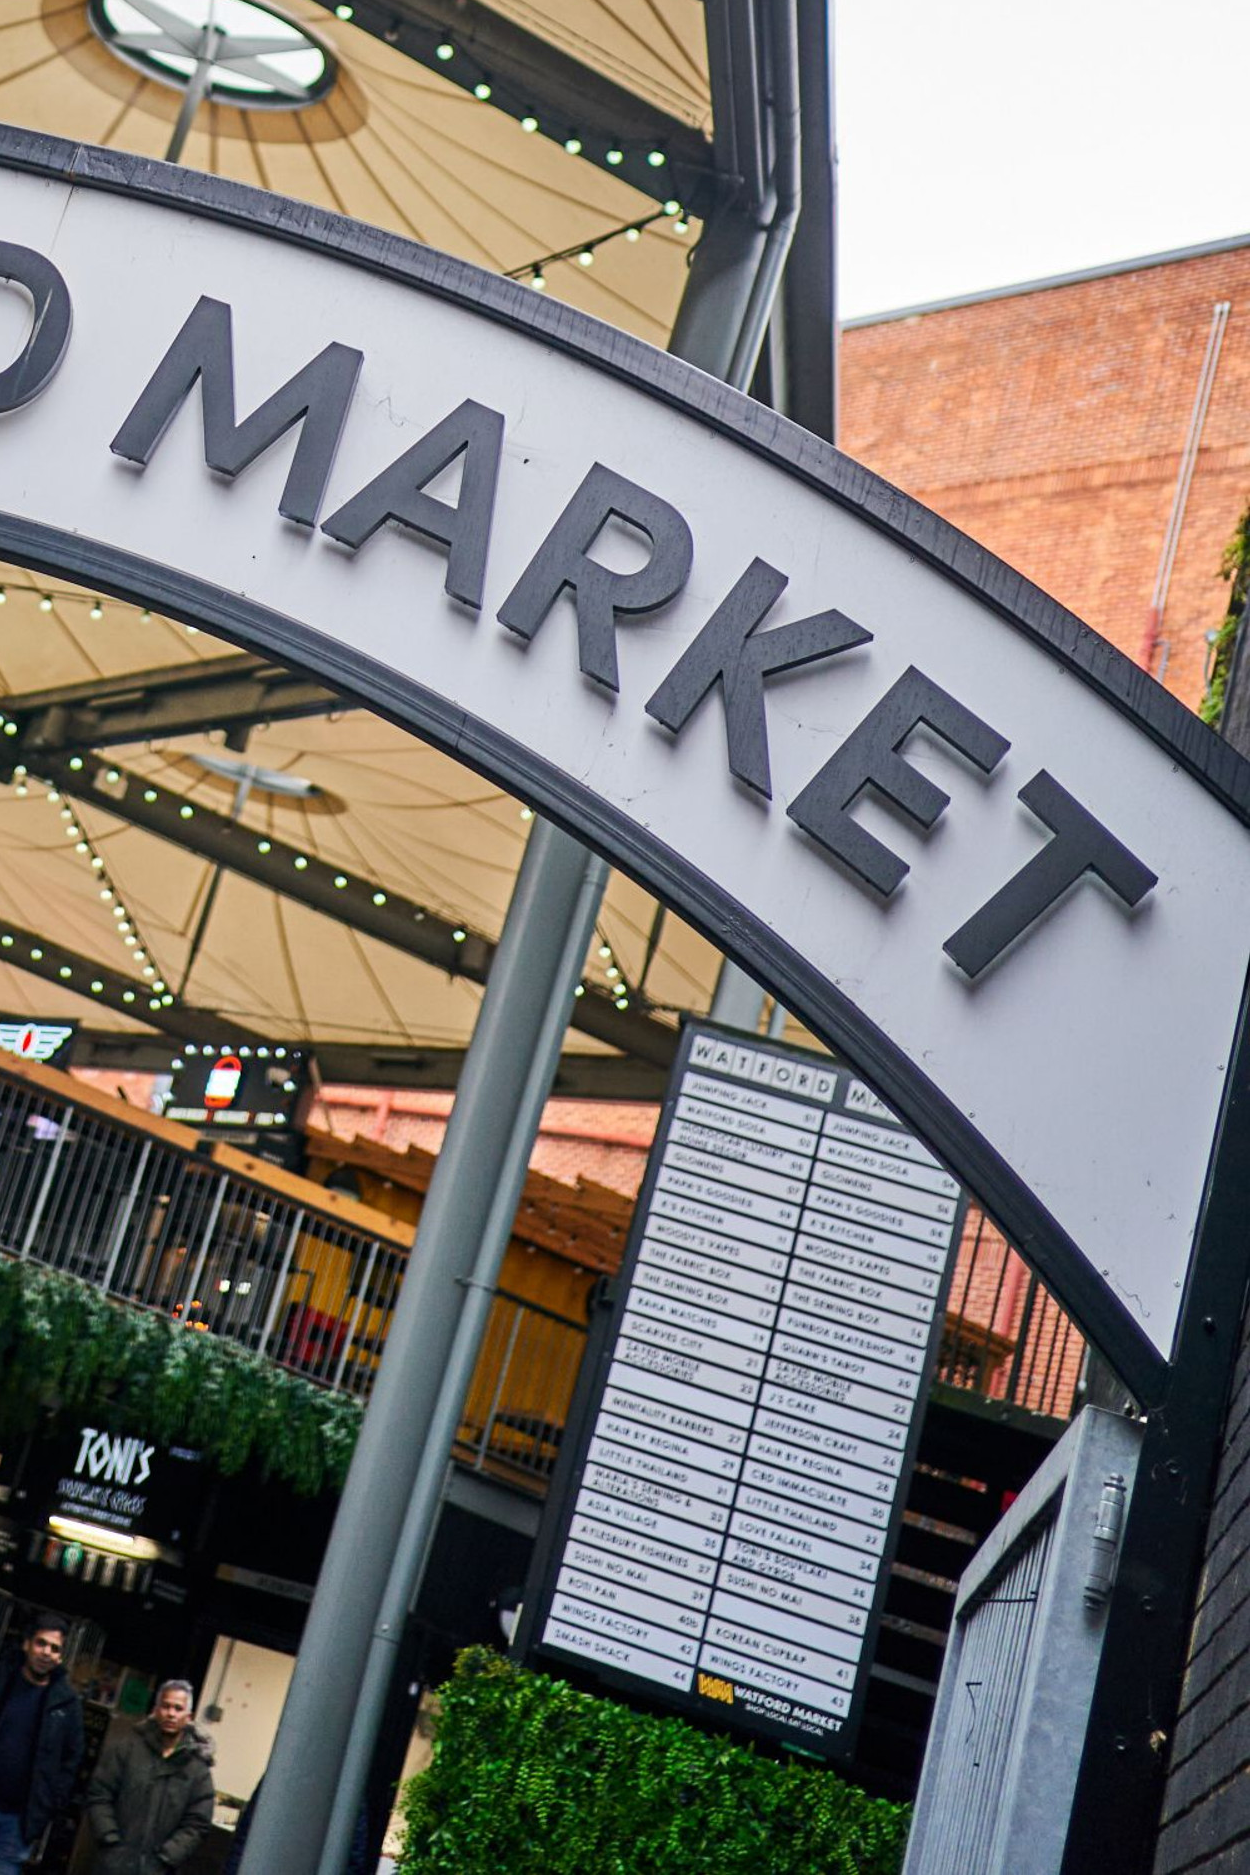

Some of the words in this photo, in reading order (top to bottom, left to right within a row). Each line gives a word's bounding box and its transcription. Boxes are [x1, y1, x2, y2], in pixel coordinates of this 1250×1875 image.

[108, 295, 1159, 979] MARKET
[694, 1042, 831, 1095] WATFORD
[73, 1427, 156, 1485] TONI'S
[732, 1683, 792, 1715] WATFORD
[790, 1704, 843, 1734] MARKET
